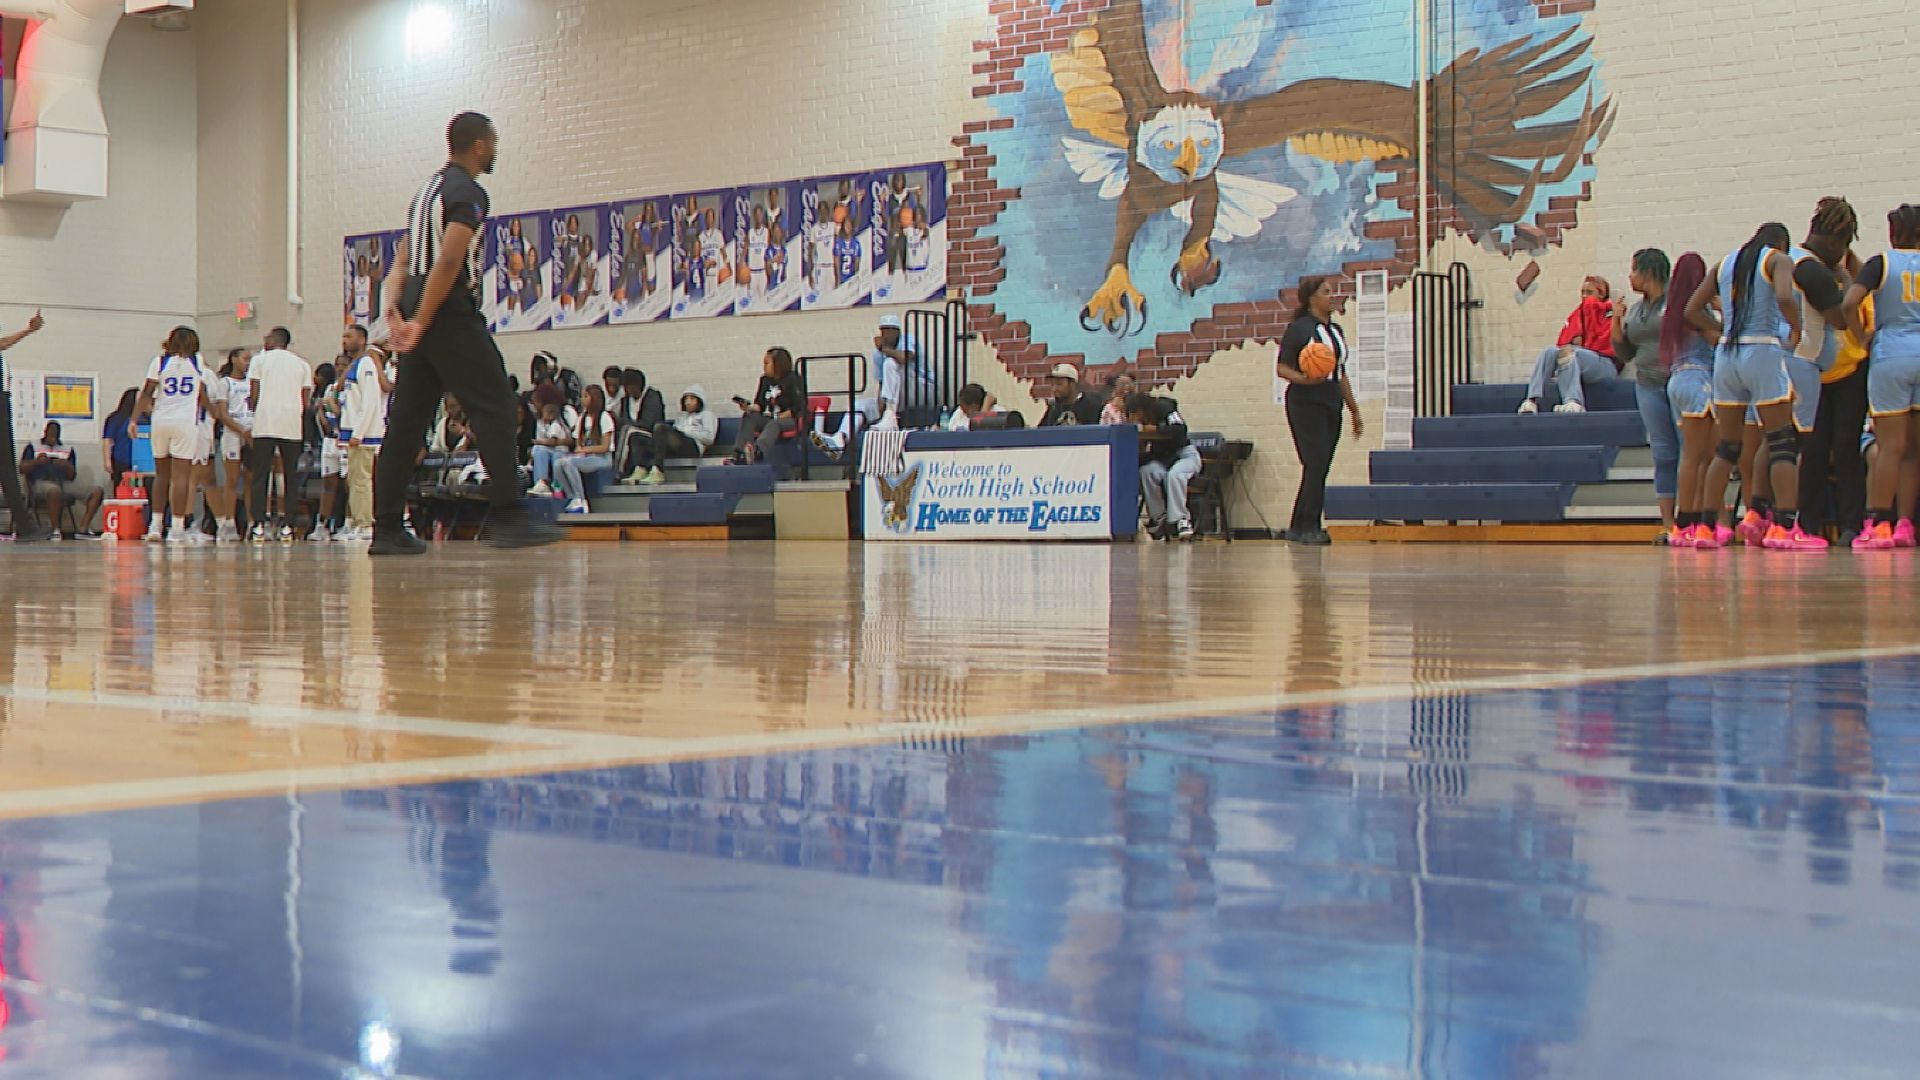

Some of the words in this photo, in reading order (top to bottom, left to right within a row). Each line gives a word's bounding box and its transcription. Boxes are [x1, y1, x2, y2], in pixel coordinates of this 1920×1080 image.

[871, 181, 889, 256] Eagles
[610, 211, 625, 277] Eagles
[841, 255, 852, 275] 2
[163, 376, 194, 394] 35
[929, 461, 994, 478] Welcome
[998, 462, 1012, 475] to
[922, 479, 974, 498] North
[978, 476, 1024, 501] High
[1029, 473, 1096, 495] School
[106, 511, 118, 530] G
[915, 502, 972, 532] HOME
[974, 508, 995, 524] OF
[998, 507, 1029, 524] THE
[1028, 500, 1102, 532] EAGLES
